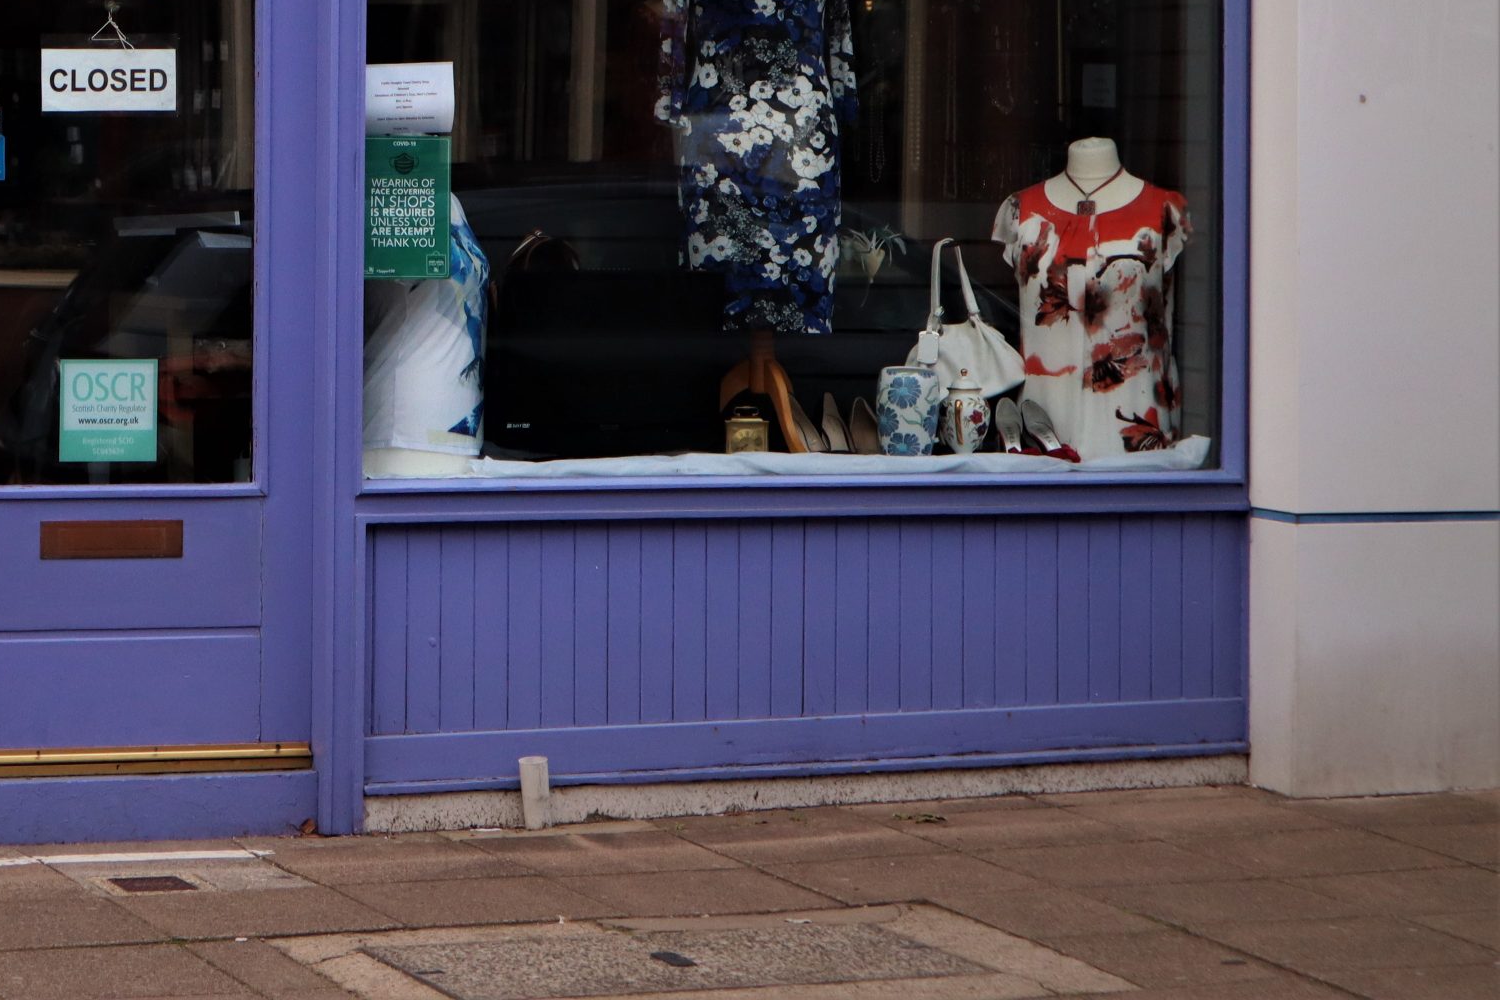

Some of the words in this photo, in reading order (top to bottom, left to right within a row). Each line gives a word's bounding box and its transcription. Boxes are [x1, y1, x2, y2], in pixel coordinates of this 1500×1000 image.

[49, 68, 168, 93] CLOSED
[372, 179, 418, 188] WEARING
[421, 179, 435, 188] OF
[371, 196, 384, 207] IN
[389, 196, 435, 208] SHOPS
[371, 208, 379, 216] IS
[383, 208, 435, 217] REQUIRED
[371, 218, 410, 226] UNLESS
[413, 218, 435, 226] YOU
[371, 227, 391, 235] ARE
[395, 227, 434, 235] EXEMPT
[371, 238, 410, 247] THANK
[412, 238, 436, 247] YOU
[72, 372, 147, 402] OSCR
[72, 404, 94, 413] Scottish
[118, 404, 147, 414] Regulator
[78, 416, 139, 426] www.oscr.org.uk
